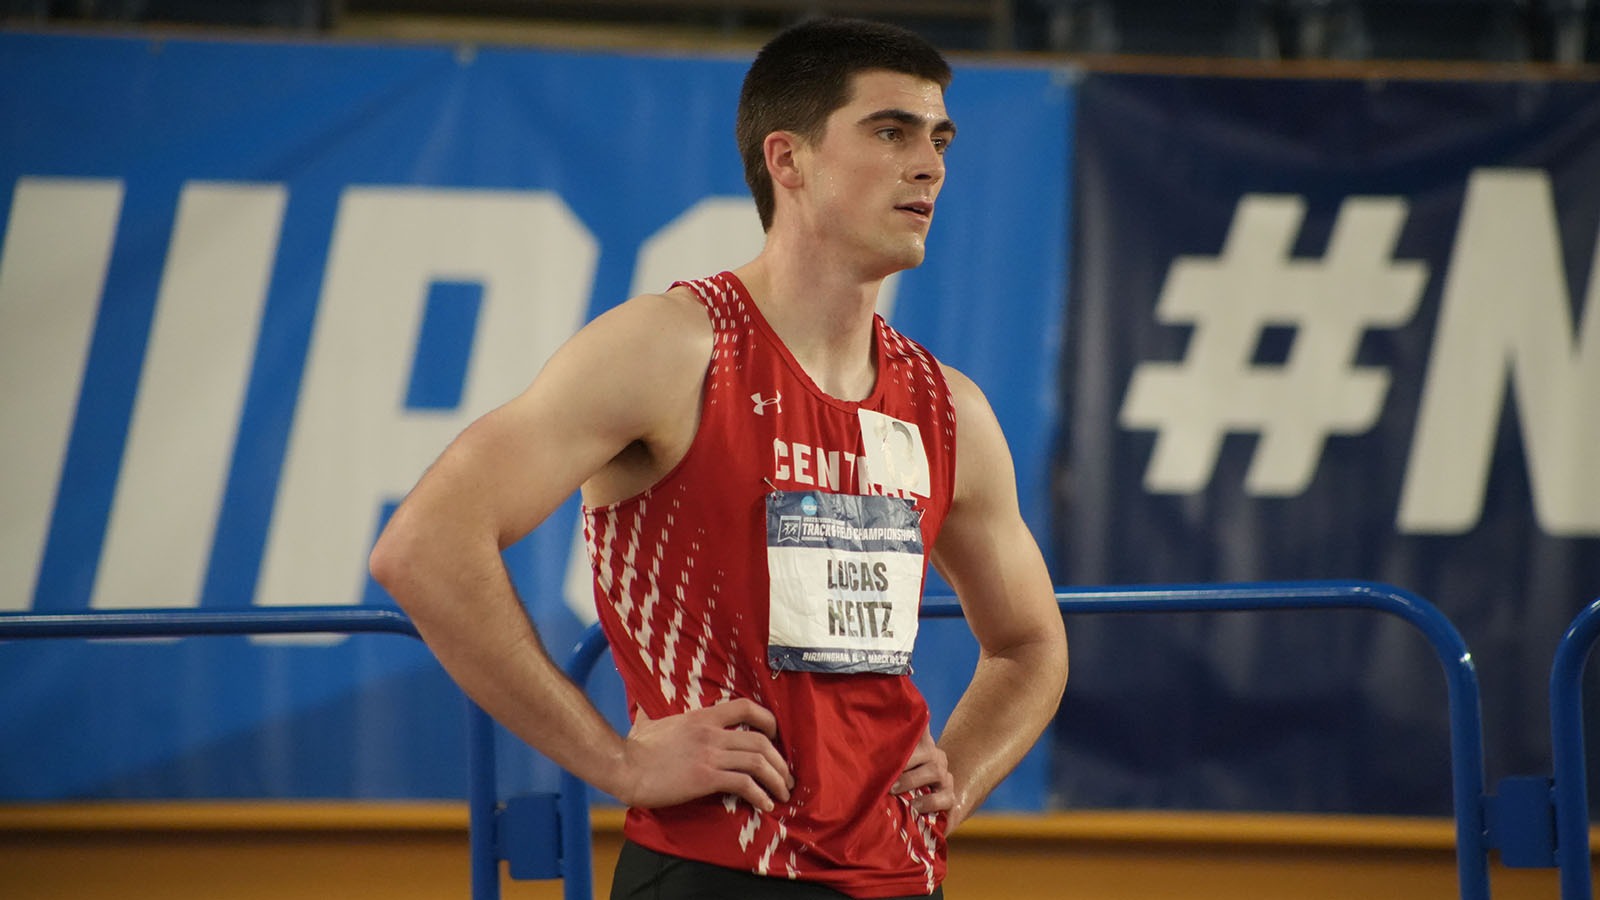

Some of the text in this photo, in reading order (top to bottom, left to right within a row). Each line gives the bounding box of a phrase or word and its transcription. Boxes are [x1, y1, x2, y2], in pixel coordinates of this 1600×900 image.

[773, 438, 919, 506] CENT
[853, 527, 917, 542] CHAMPIONSHIPS
[827, 559, 889, 592] LUCAS
[827, 599, 894, 639] HEITZ
